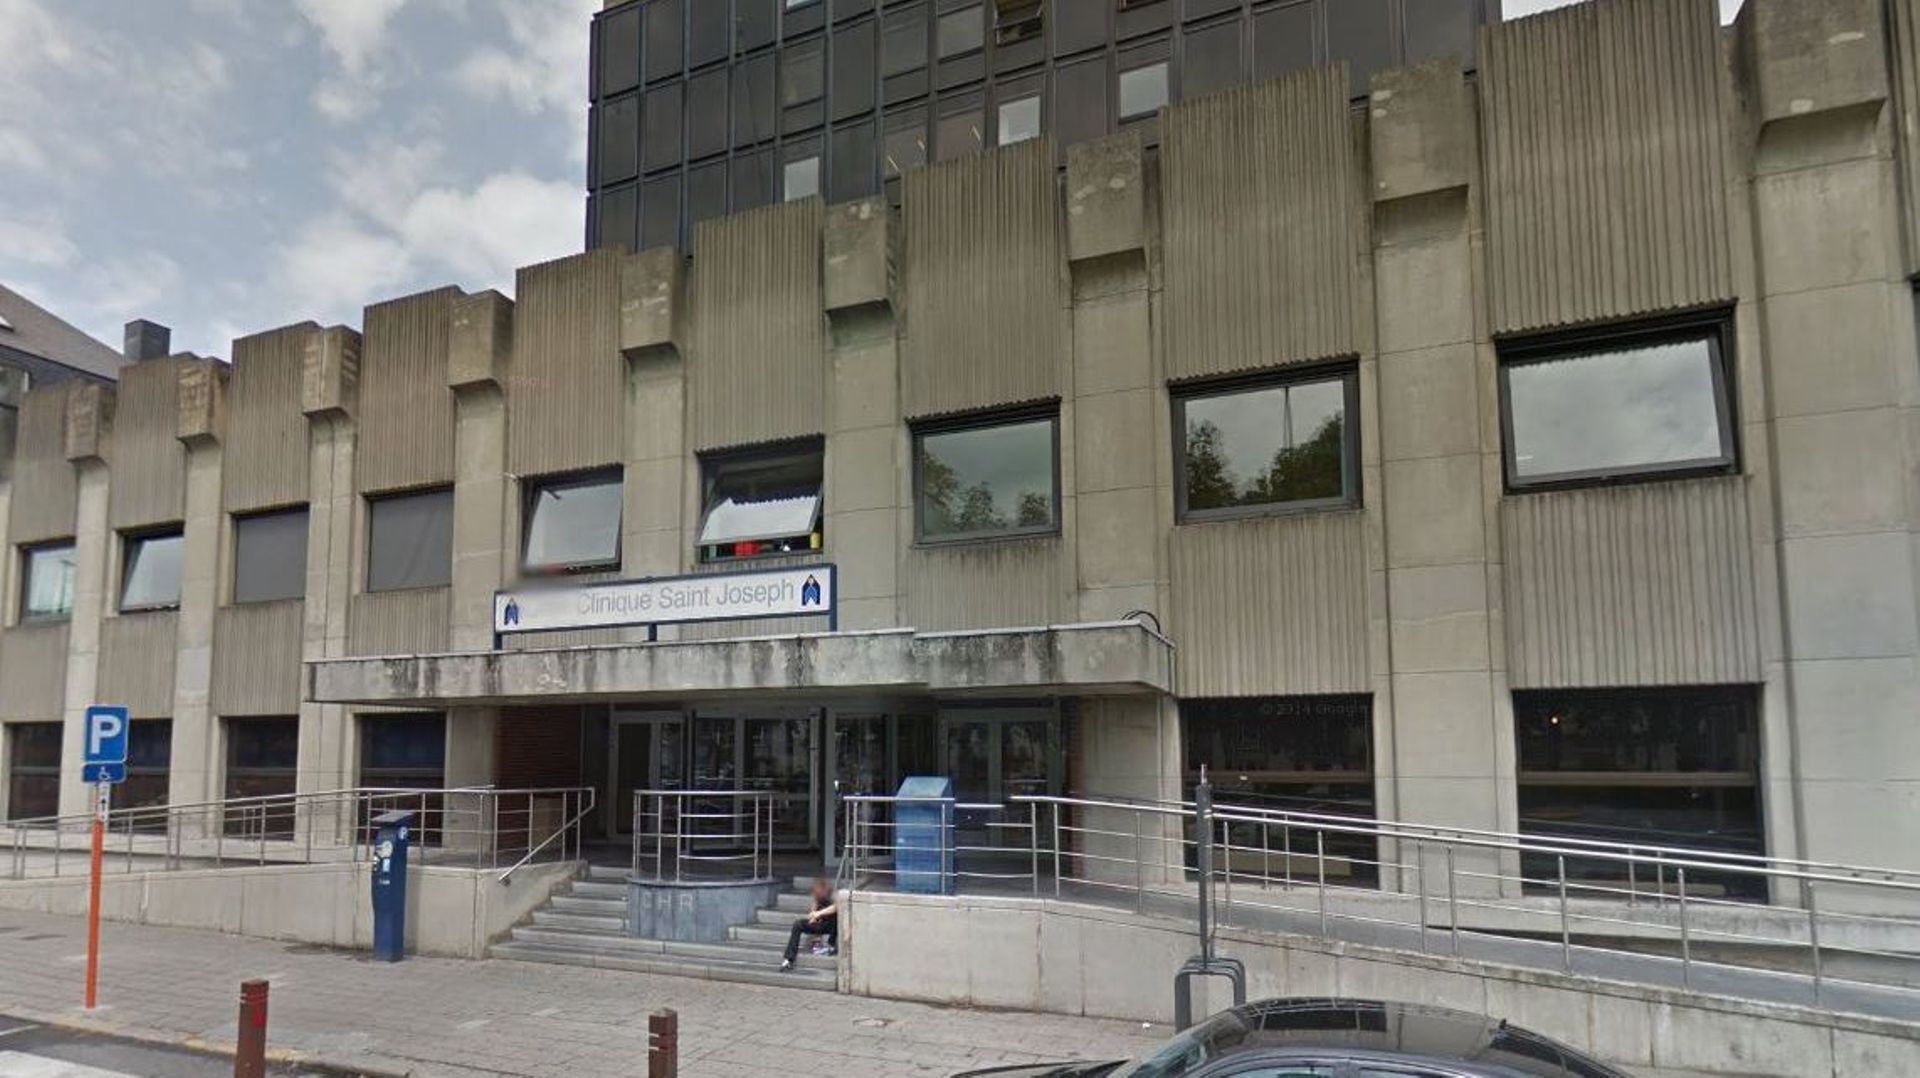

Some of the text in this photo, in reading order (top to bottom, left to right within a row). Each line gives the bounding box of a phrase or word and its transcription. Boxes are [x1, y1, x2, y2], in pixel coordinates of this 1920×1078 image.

[577, 578, 794, 615] Clinique Saint Joseph
[90, 713, 121, 754] P
[399, 826, 407, 840] P
